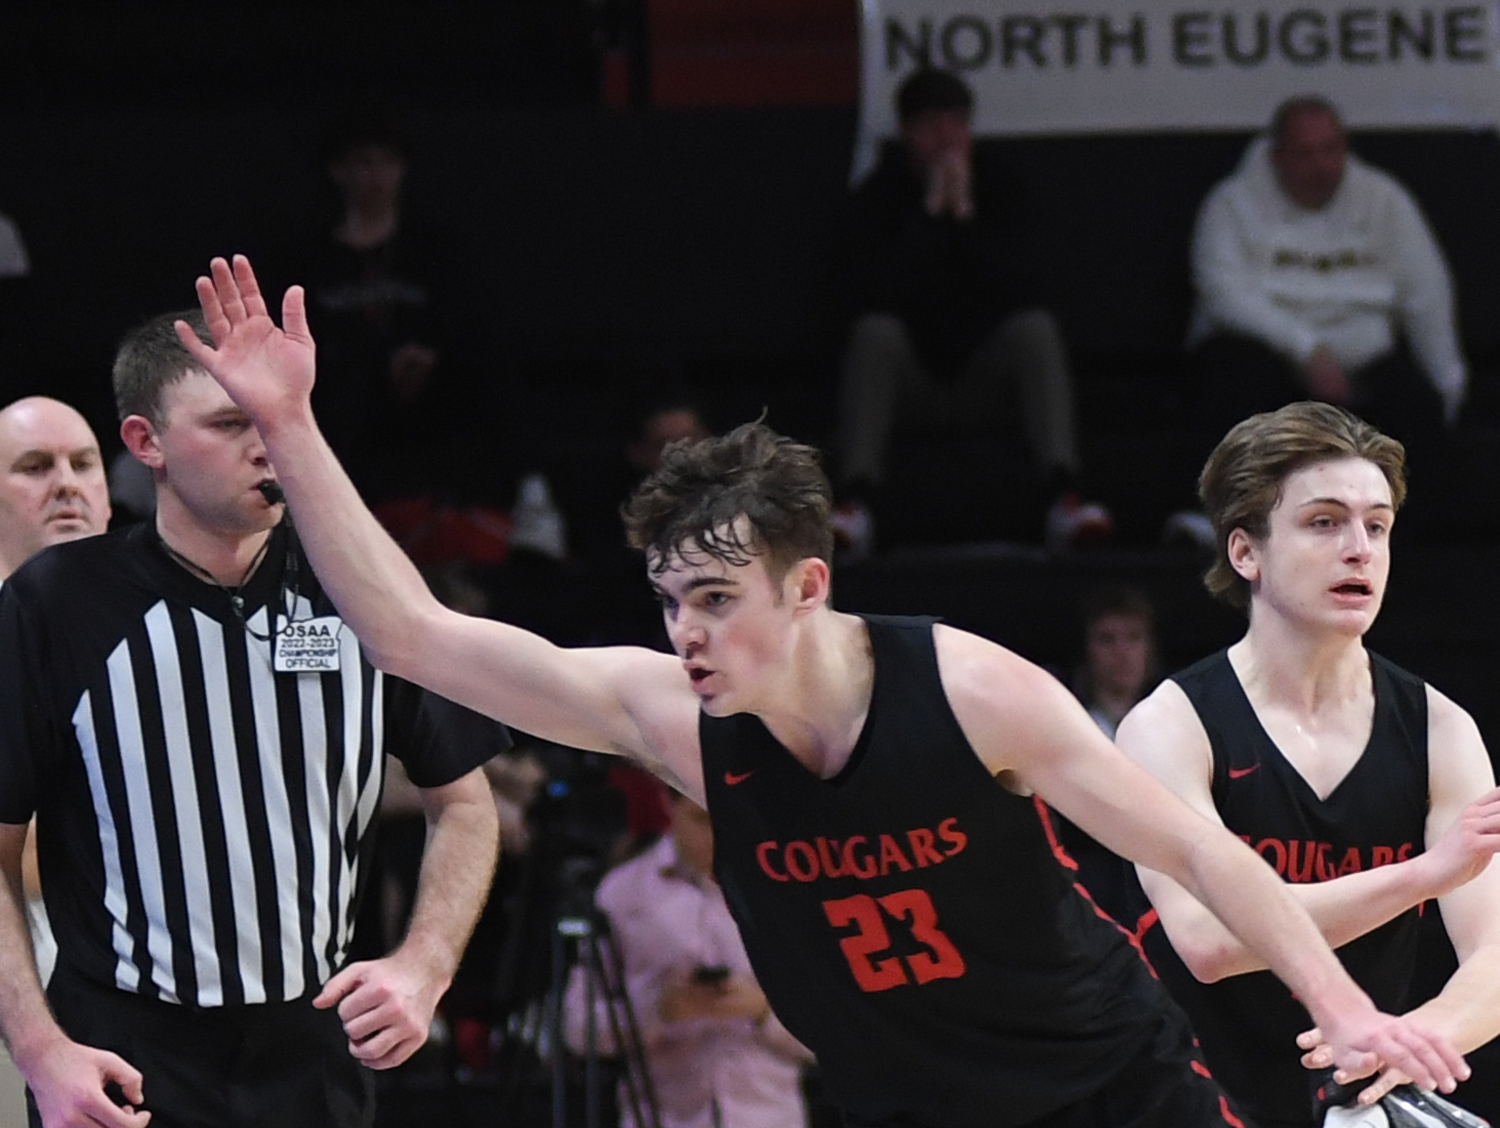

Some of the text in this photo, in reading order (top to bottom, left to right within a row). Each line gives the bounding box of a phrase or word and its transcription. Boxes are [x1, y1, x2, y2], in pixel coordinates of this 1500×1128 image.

[884, 7, 1487, 70] NORTH EUGENE
[281, 638, 334, 648] 2022-2023
[283, 625, 331, 637] OSAA
[279, 649, 337, 658] CHAMPIONSHIP
[286, 659, 331, 668] OFFICIAL
[755, 817, 968, 883] COUGARS
[1238, 834, 1413, 882] OUGAR
[822, 888, 967, 992] 23
